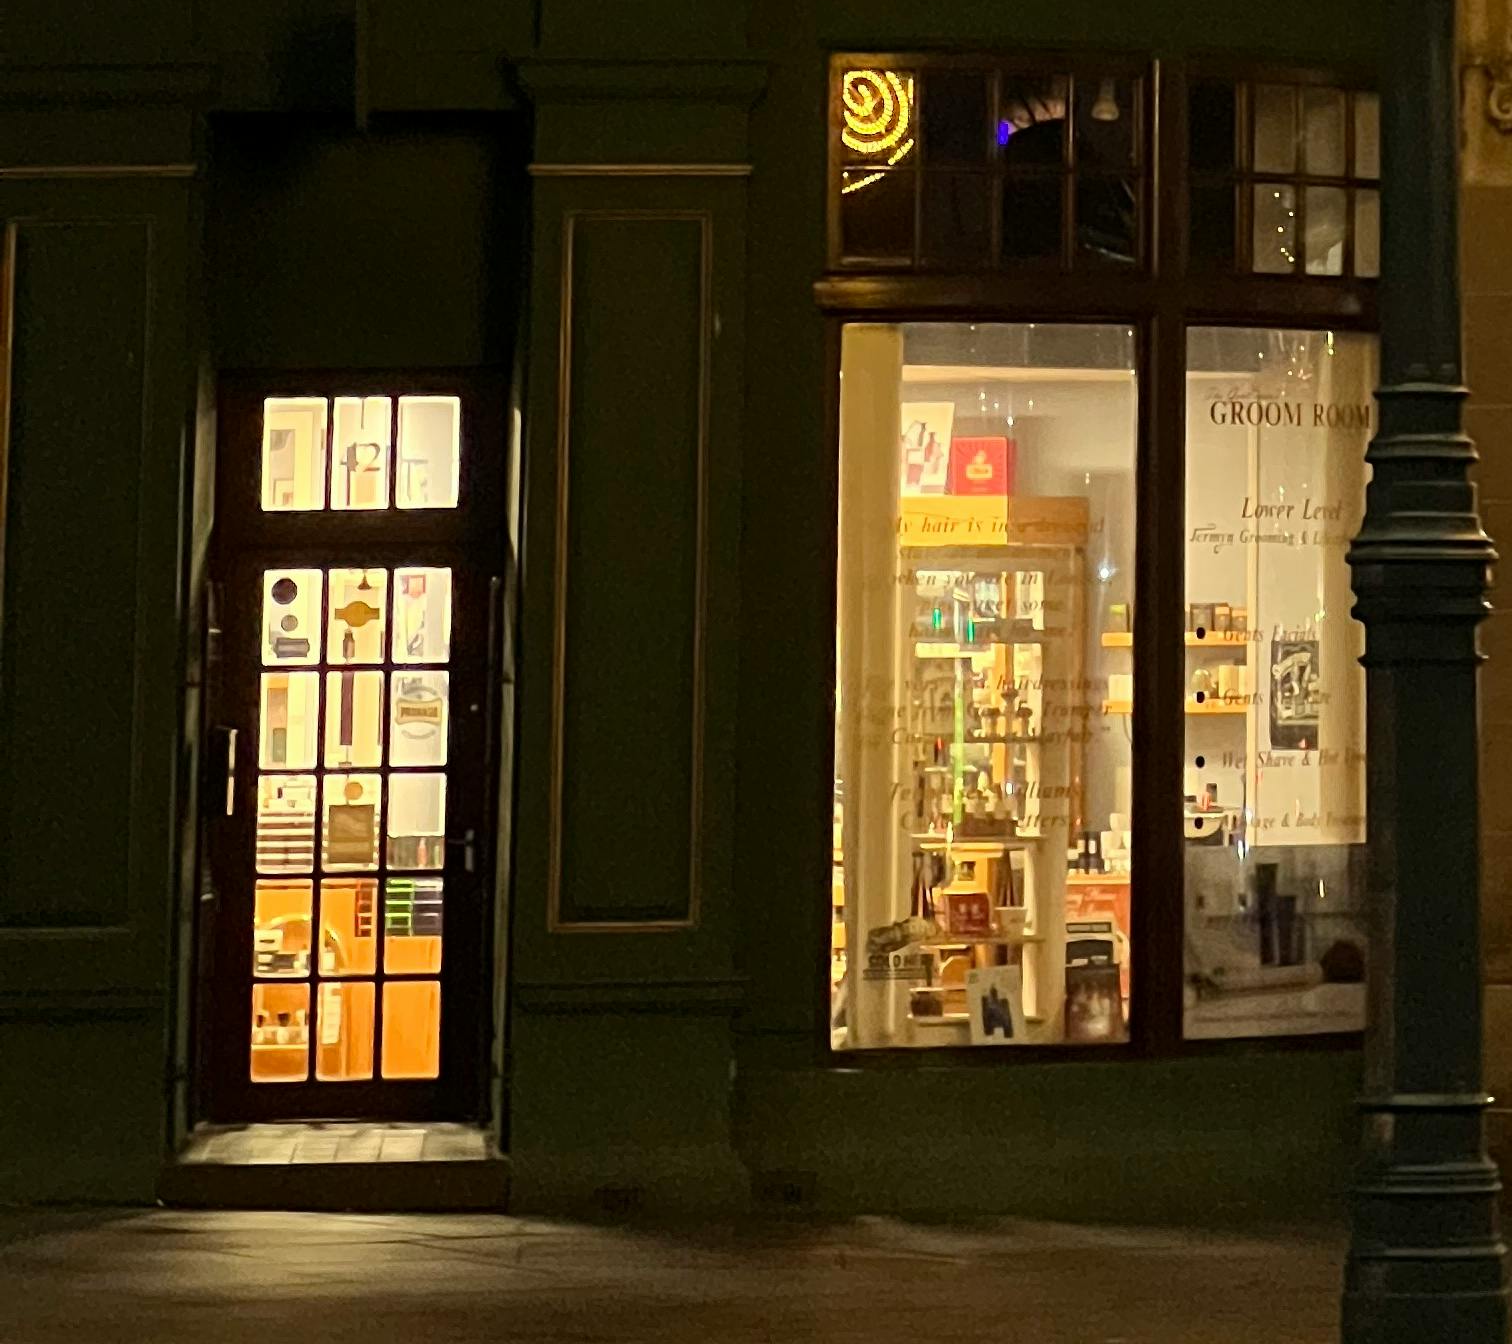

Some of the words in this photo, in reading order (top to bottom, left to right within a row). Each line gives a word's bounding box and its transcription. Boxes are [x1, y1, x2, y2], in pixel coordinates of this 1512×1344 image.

[1210, 400, 1303, 427] GROOM
[1313, 402, 1371, 429] ROOM
[340, 441, 382, 473] 42
[1241, 497, 1296, 521] Lower
[1302, 498, 1344, 521] Level
[921, 516, 960, 533] hair
[967, 516, 984, 533] is
